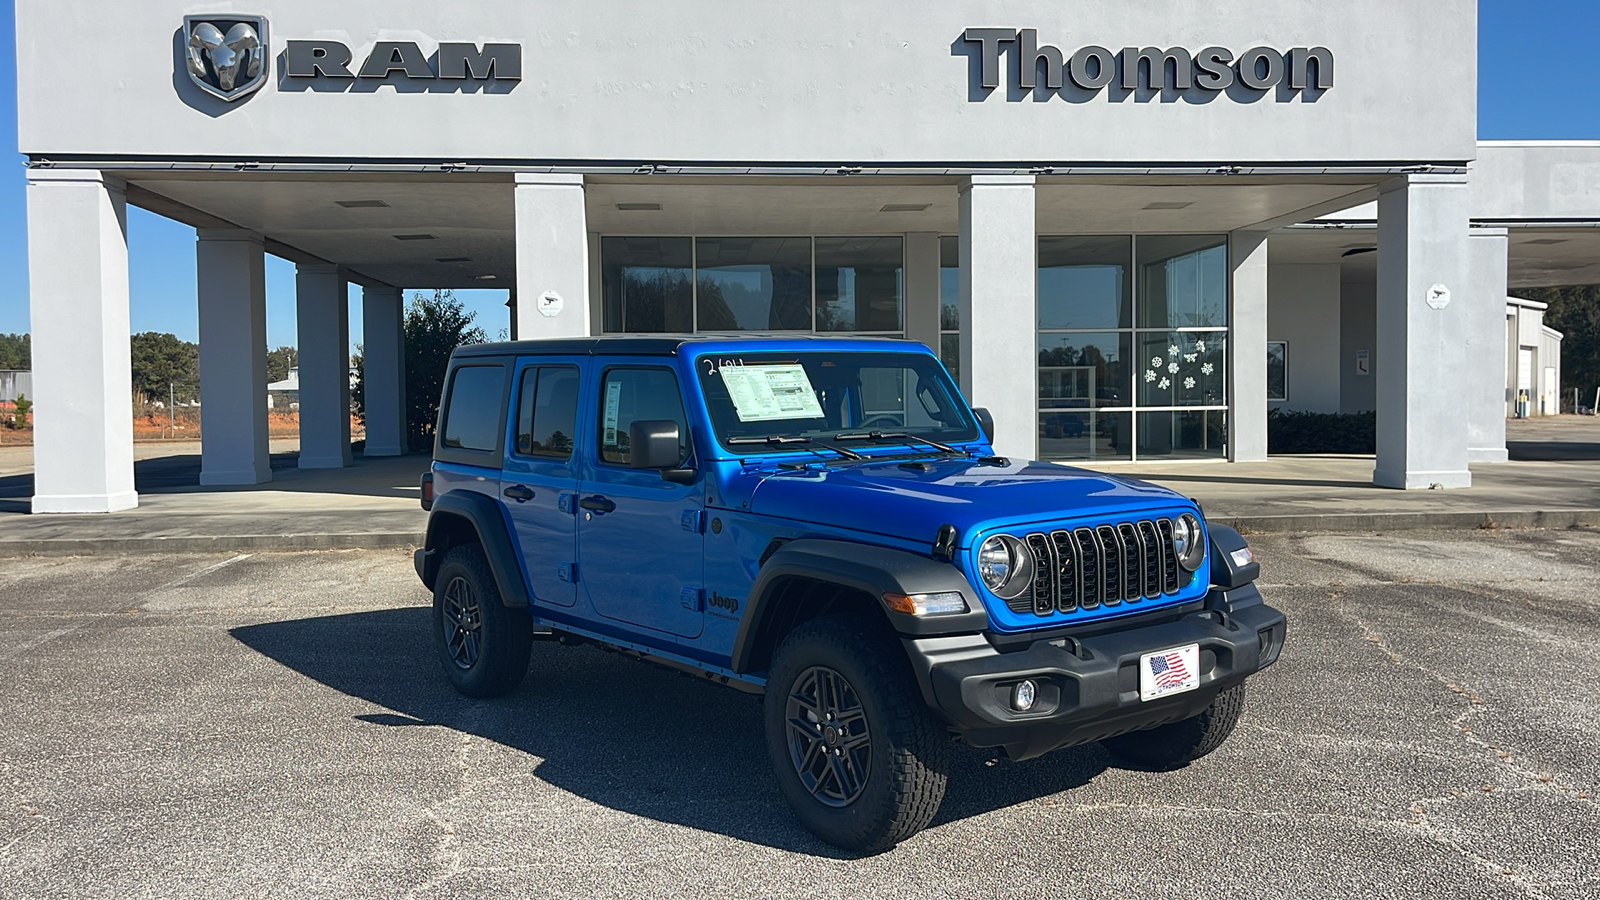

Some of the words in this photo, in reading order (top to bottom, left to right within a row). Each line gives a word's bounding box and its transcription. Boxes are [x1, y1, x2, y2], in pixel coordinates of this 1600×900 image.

[286, 40, 522, 79] RAM
[964, 27, 1334, 90] Thomson
[708, 590, 739, 614] Jeep
